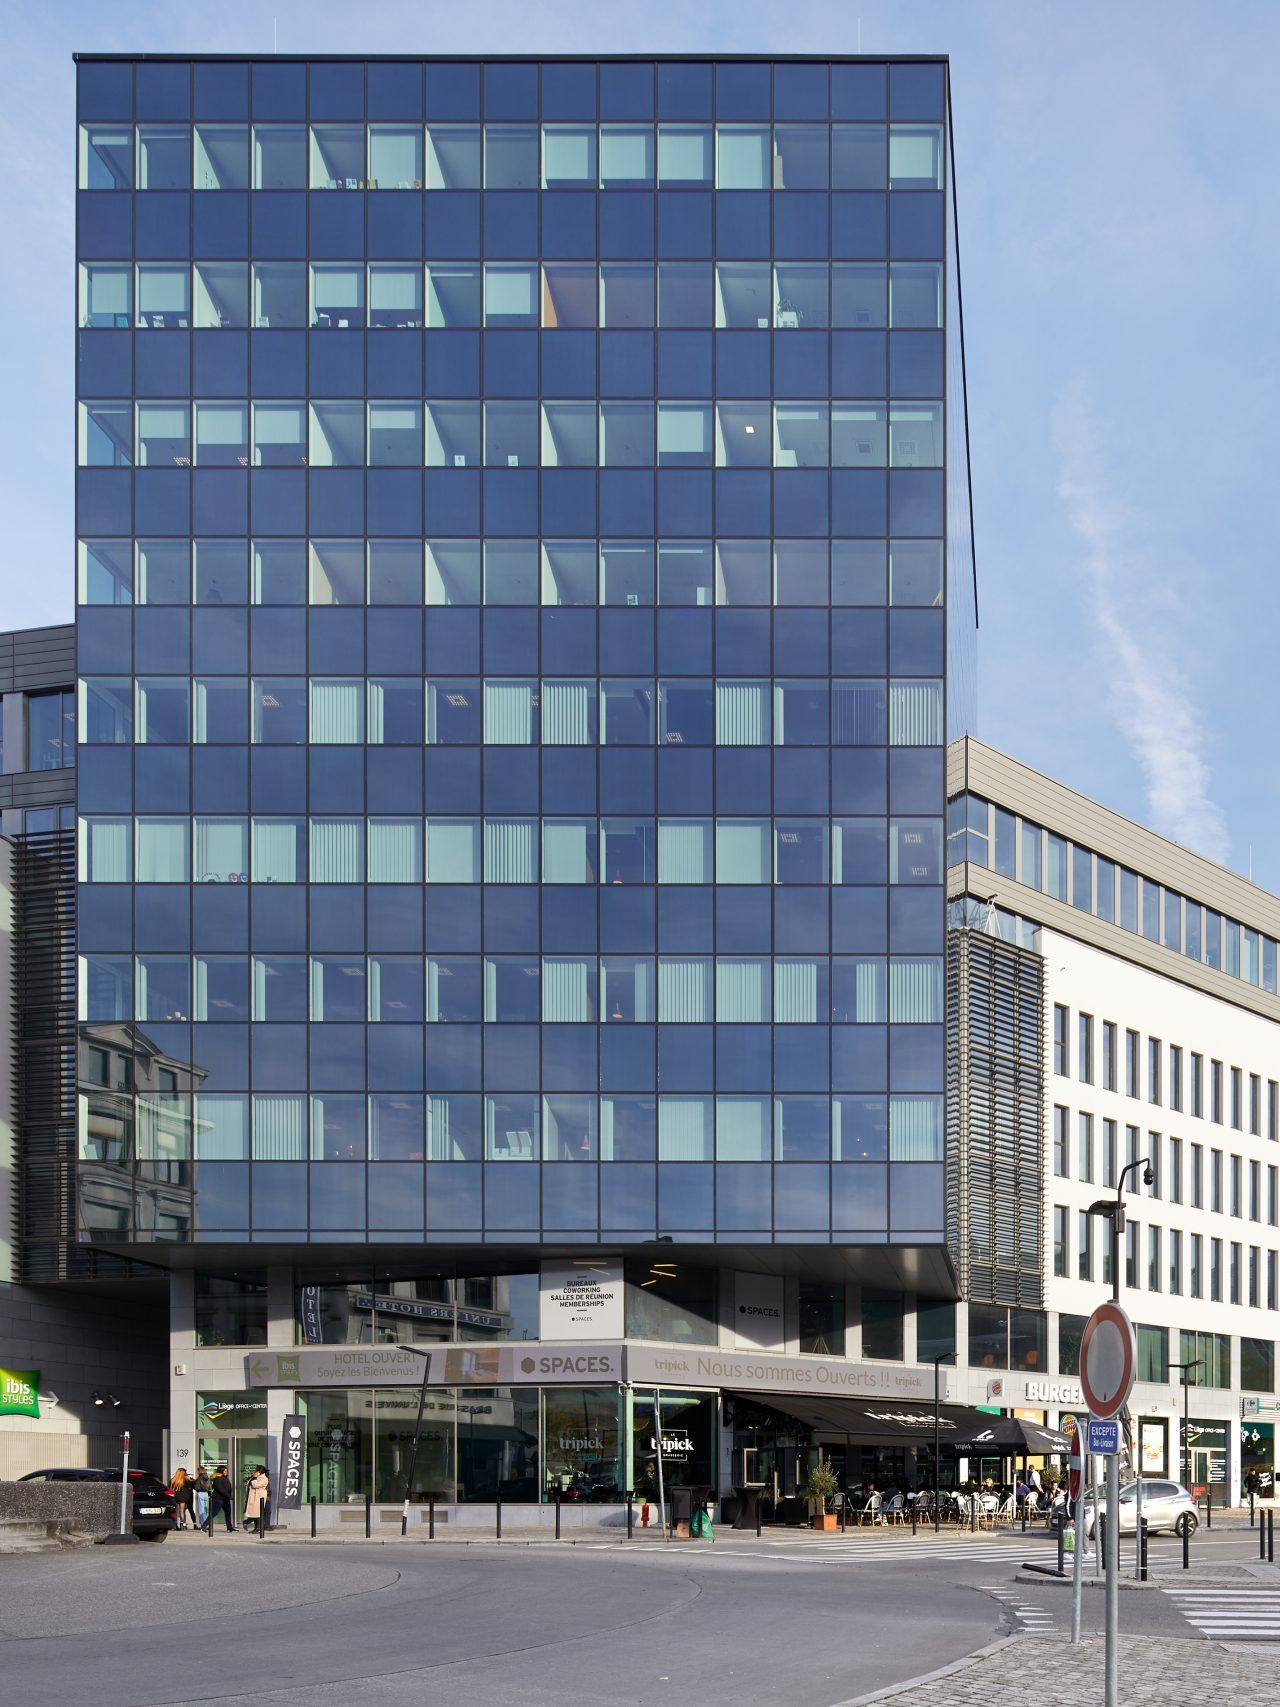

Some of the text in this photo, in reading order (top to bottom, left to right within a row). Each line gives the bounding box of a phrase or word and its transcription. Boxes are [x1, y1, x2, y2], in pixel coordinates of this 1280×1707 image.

[559, 1300, 605, 1308] MEMBERSHIPS
[334, 1353, 417, 1365] HOTEL OUVERT
[539, 1356, 614, 1374] SPACES.
[655, 1358, 690, 1373] tripick
[317, 1367, 346, 1378] Soyez
[348, 1366, 362, 1377] les
[363, 1366, 414, 1377] Bienvenus
[697, 1357, 742, 1377] Nous
[746, 1364, 812, 1383] sommes
[816, 1366, 877, 1387] Ouverts
[6, 1378, 30, 1394] ibis
[559, 1436, 605, 1452] tripick
[176, 1448, 189, 1458] 139
[284, 1441, 301, 1499] SPACES.
